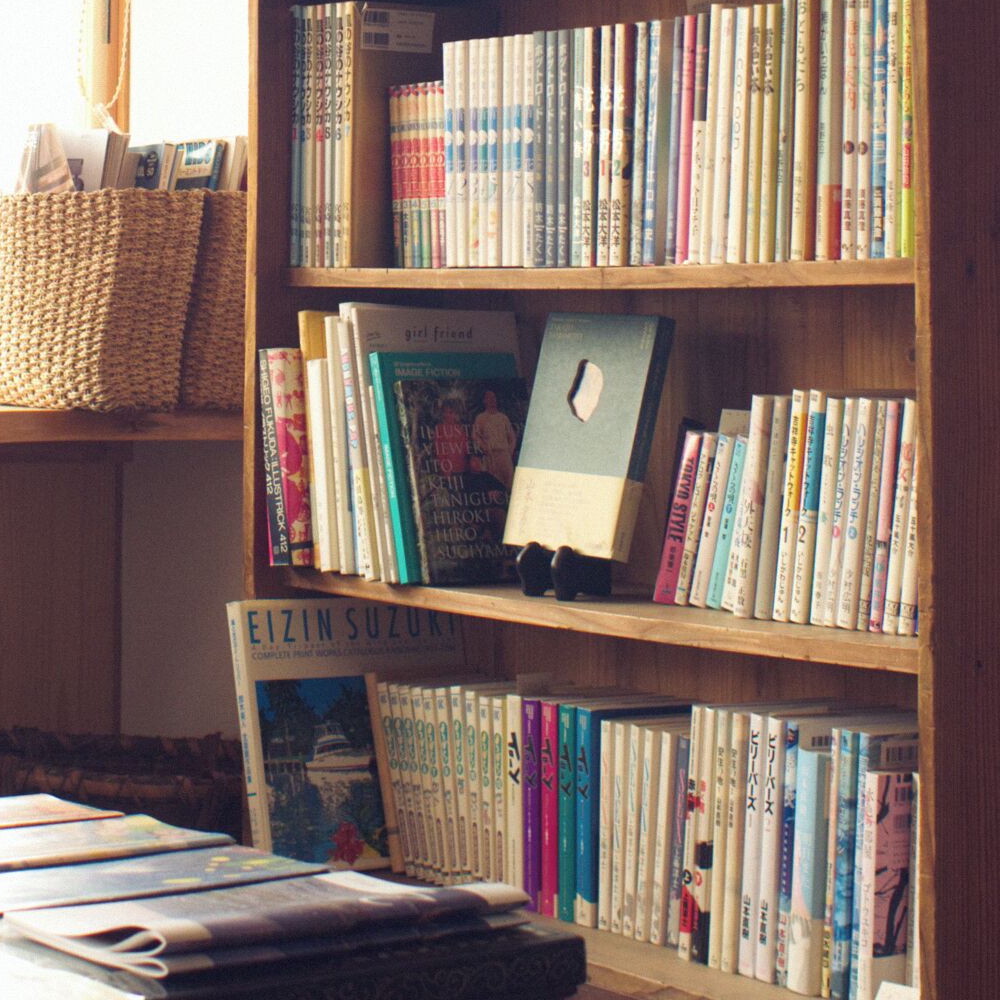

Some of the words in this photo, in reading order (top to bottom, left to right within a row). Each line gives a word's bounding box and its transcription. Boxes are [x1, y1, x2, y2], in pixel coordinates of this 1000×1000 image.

[405, 327, 428, 342] girl
[434, 326, 473, 340] friend
[394, 368, 424, 377] IMAGE
[426, 368, 461, 377] FICTION
[259, 359, 271, 406] SHIGEO
[279, 534, 289, 553] 412
[265, 471, 273, 495] 412
[428, 475, 465, 490] KEIJI
[676, 457, 695, 500] TOKYO
[433, 509, 491, 525] HIROKI
[669, 502, 688, 543] STYLE
[436, 527, 478, 541] HIRO
[782, 527, 788, 543] 1
[798, 525, 806, 543] 2
[247, 608, 333, 644] EIZIN
[251, 650, 291, 661] COMPLETE
[747, 730, 760, 812] ビリーバーズ
[764, 733, 778, 816] ビリーバーズ
